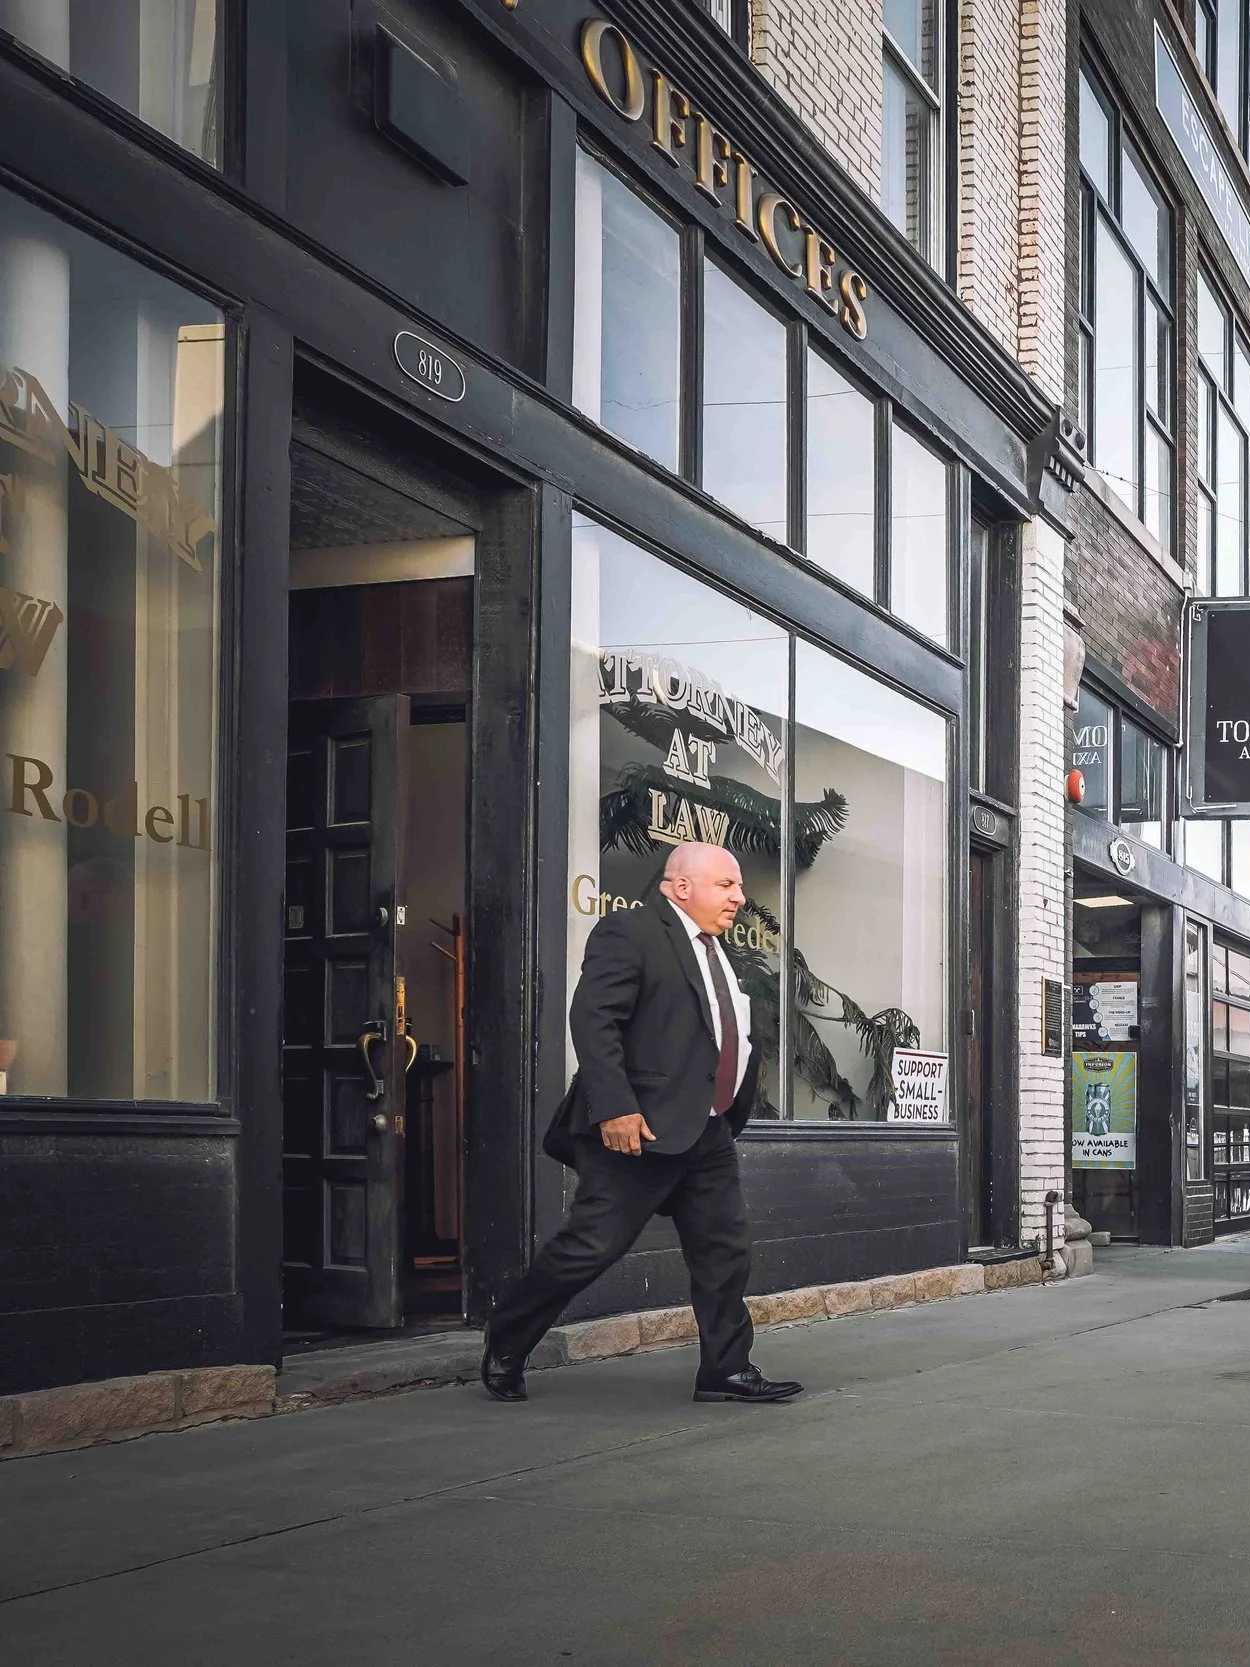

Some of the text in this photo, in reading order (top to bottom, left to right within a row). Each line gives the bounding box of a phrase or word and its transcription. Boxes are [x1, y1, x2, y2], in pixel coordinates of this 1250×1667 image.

[1181, 92, 1233, 224] ESCAPE
[581, 17, 868, 341] OFFICES
[419, 349, 442, 385] 819
[663, 728, 716, 790] AT
[5, 753, 212, 851] Rodell
[648, 788, 730, 847] LAW
[1118, 849, 1130, 865] 815
[898, 1060, 943, 1079] SUPPORT
[894, 1103, 939, 1120] BUSINESS
[1082, 1149, 1112, 1158] IN CANS
[1087, 1139, 1128, 1148] AVAILABLE
